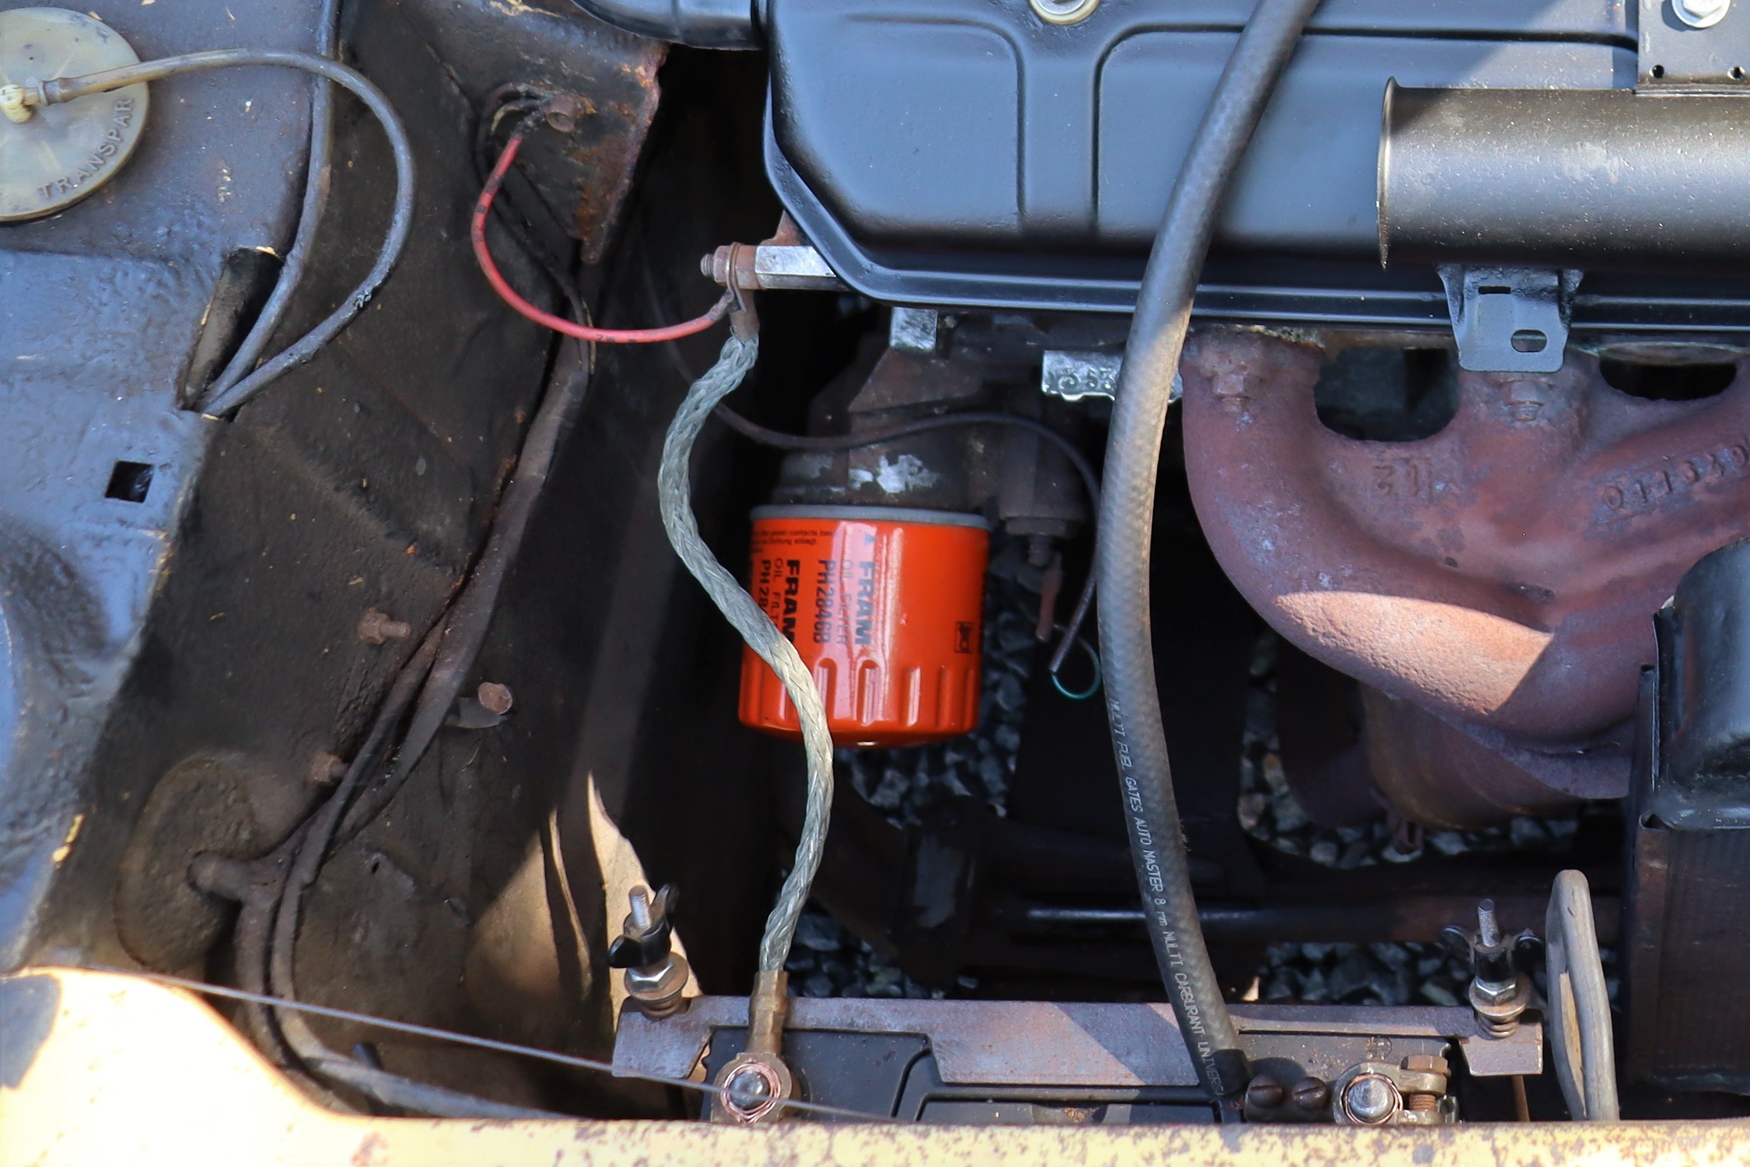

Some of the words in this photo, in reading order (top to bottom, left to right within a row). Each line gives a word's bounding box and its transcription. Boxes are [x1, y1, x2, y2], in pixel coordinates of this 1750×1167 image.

[37, 97, 135, 199] TRANSPAR
[774, 557, 784, 583] OIL
[841, 558, 854, 580] OIL
[782, 559, 801, 643] FRAM
[813, 559, 836, 644] PH2846B
[836, 592, 852, 646] FILTER
[854, 560, 876, 646] FRAM
[1109, 698, 1126, 737] MULTI
[1117, 740, 1133, 771] FUEL
[1125, 776, 1144, 813] GATES
[1134, 816, 1153, 846] AUTO
[1142, 849, 1164, 893] MASTER
[1161, 930, 1184, 966] MULTI
[1174, 972, 1207, 1036] CARBURANT
